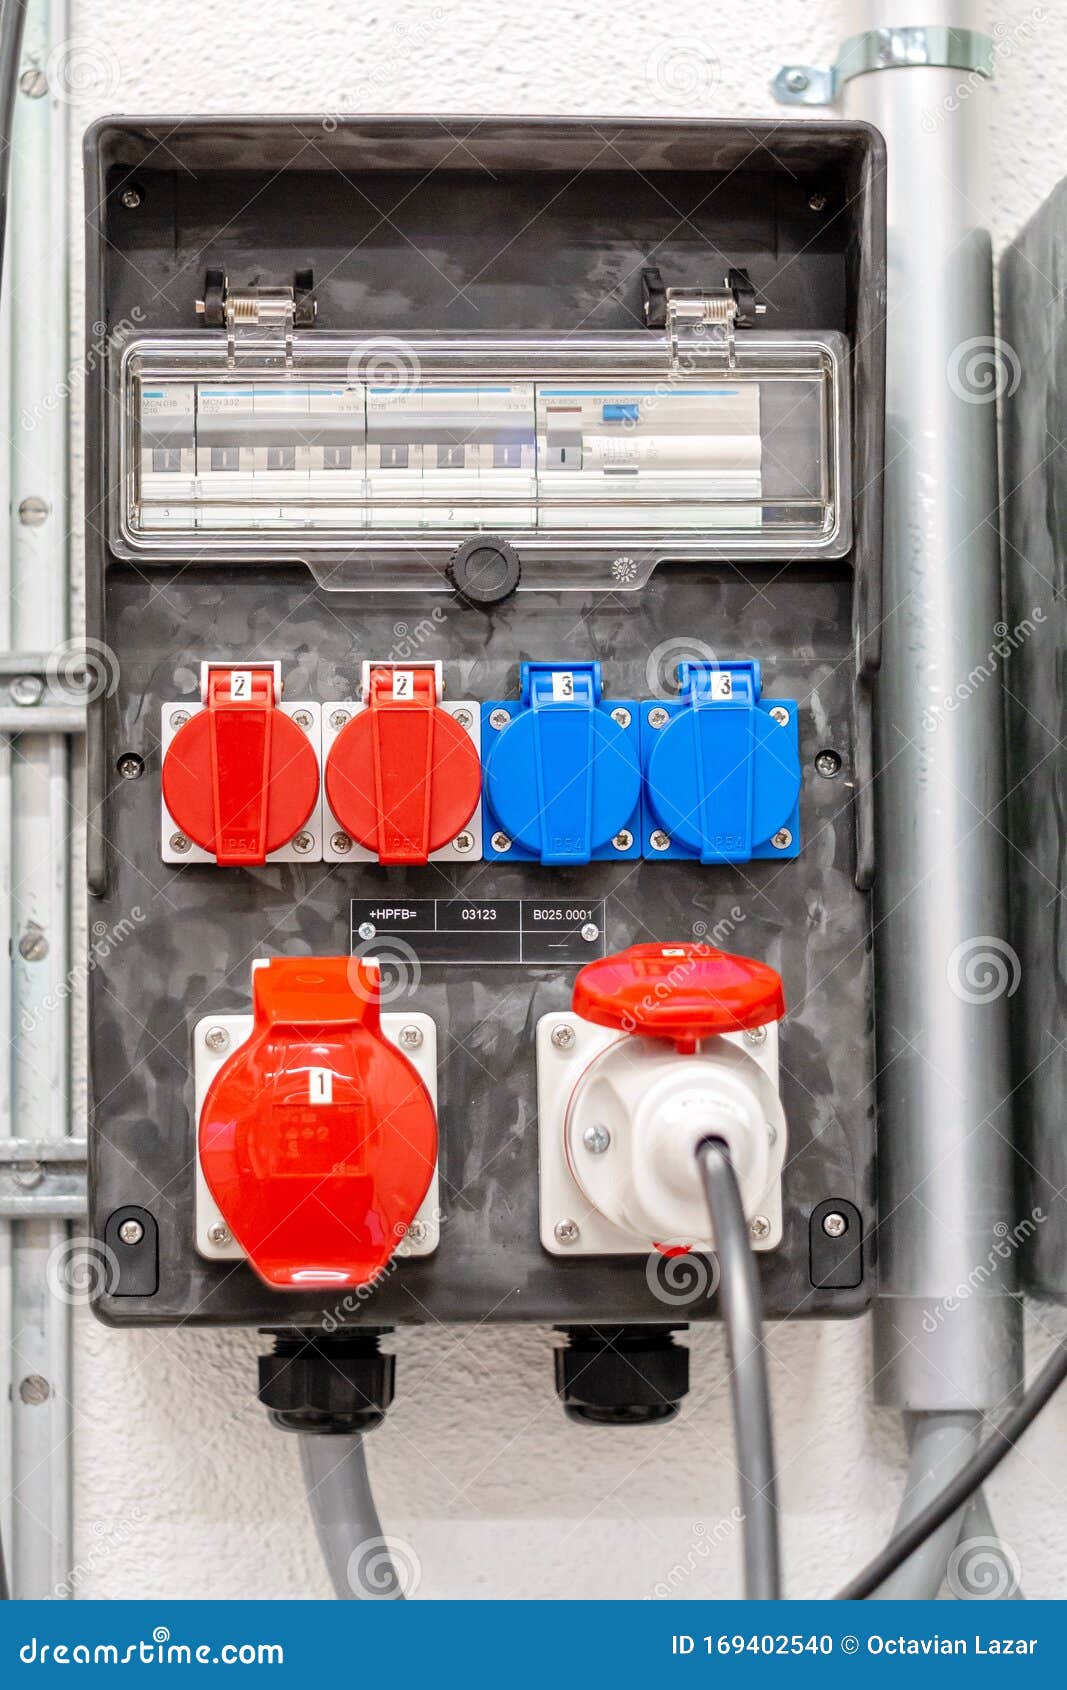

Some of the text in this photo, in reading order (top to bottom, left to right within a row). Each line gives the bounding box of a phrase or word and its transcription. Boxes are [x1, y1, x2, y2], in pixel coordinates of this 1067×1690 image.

[234, 676, 245, 696] 2
[397, 676, 407, 695] 2
[562, 675, 572, 695] 3
[721, 675, 731, 695] 3
[223, 838, 257, 850] IP54
[369, 908, 592, 921] +HPFB= 03123 B025.0001
[317, 1073, 325, 1096] 1
